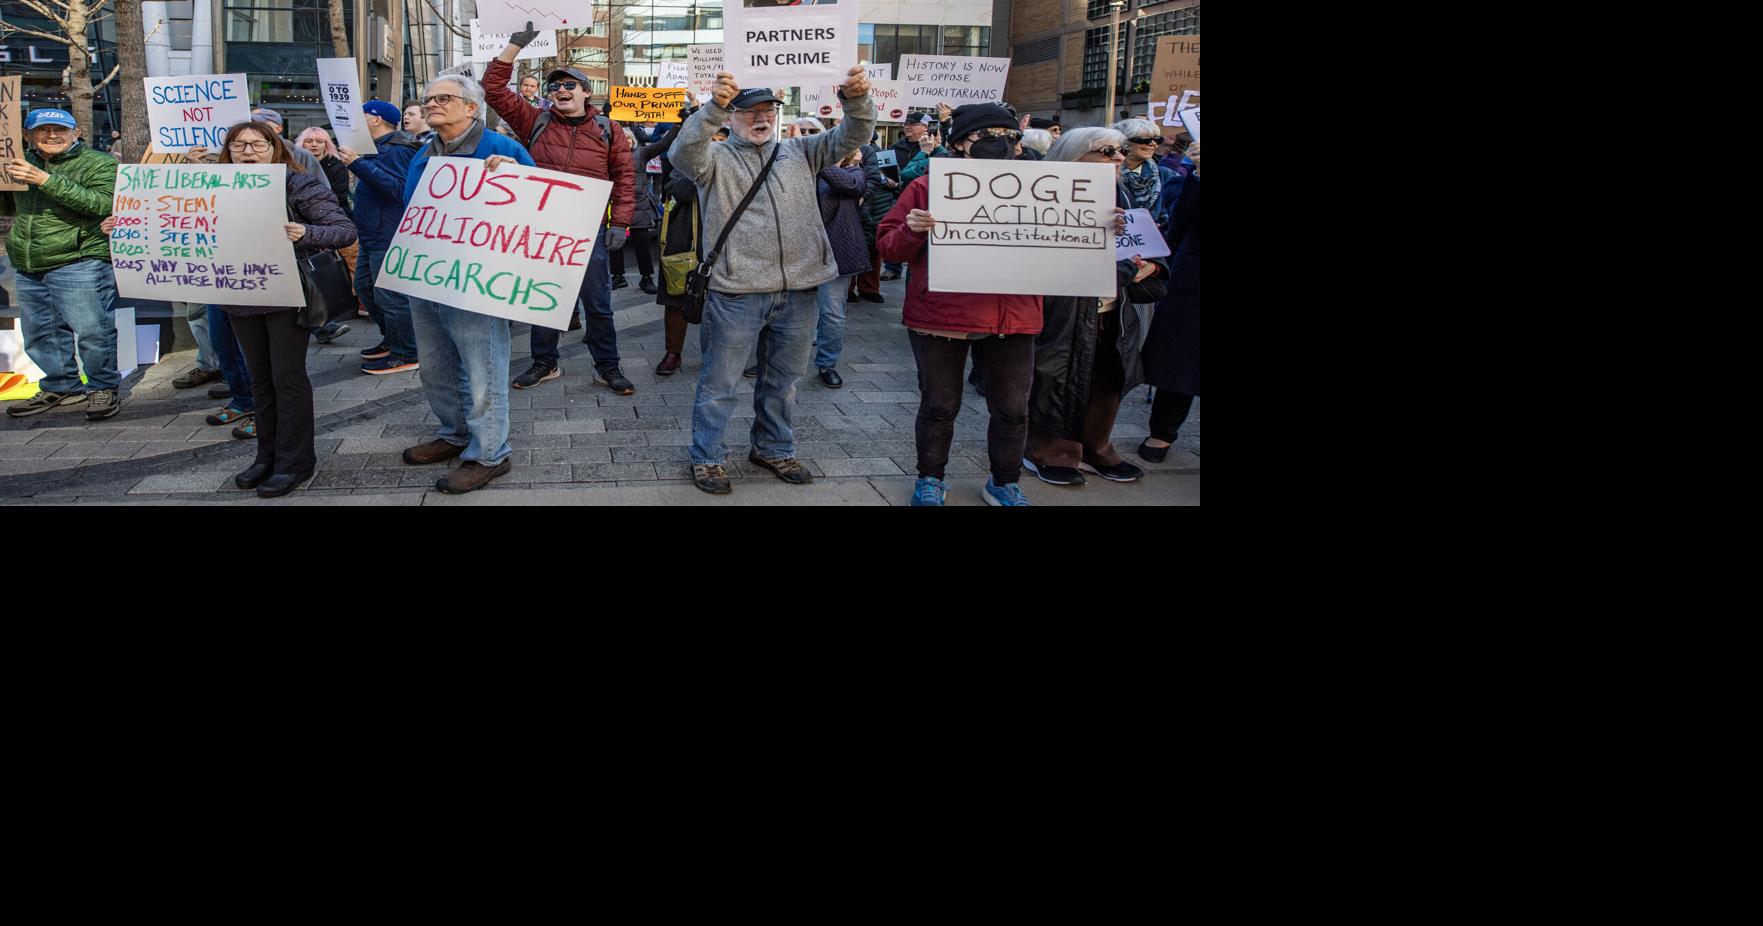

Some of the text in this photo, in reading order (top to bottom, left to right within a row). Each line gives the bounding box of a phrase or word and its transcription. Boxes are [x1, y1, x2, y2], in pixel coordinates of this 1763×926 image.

[746, 28, 835, 42] PARTNERS
[751, 52, 830, 66] IN CRIME
[906, 58, 1006, 72] HISTORY IS NOW
[908, 73, 971, 82] WE OPPOSE
[153, 80, 237, 104] SCIENCE
[616, 88, 685, 100] HANDS OFF
[912, 86, 997, 100] UTHORITARIANS
[613, 101, 638, 109] OUR
[183, 107, 213, 122] NOT
[634, 111, 665, 119] DATA!
[160, 126, 230, 147] SILENC
[120, 167, 270, 191] SAVE LIBERAL ARTS
[428, 163, 584, 211] OUST
[944, 172, 1096, 203] DOGE
[157, 194, 216, 213] STEM!
[159, 214, 218, 232] STEM!
[970, 205, 1097, 227] ACTIONS
[160, 229, 218, 248] STEM!
[399, 206, 590, 266] BILLIONAIRE
[160, 247, 214, 260] STEM!
[114, 258, 283, 276] 2025 WHY DO WE HAVE
[146, 272, 172, 285] ALL
[172, 274, 212, 287] THESE
[385, 246, 562, 311] OLIGARCHS
